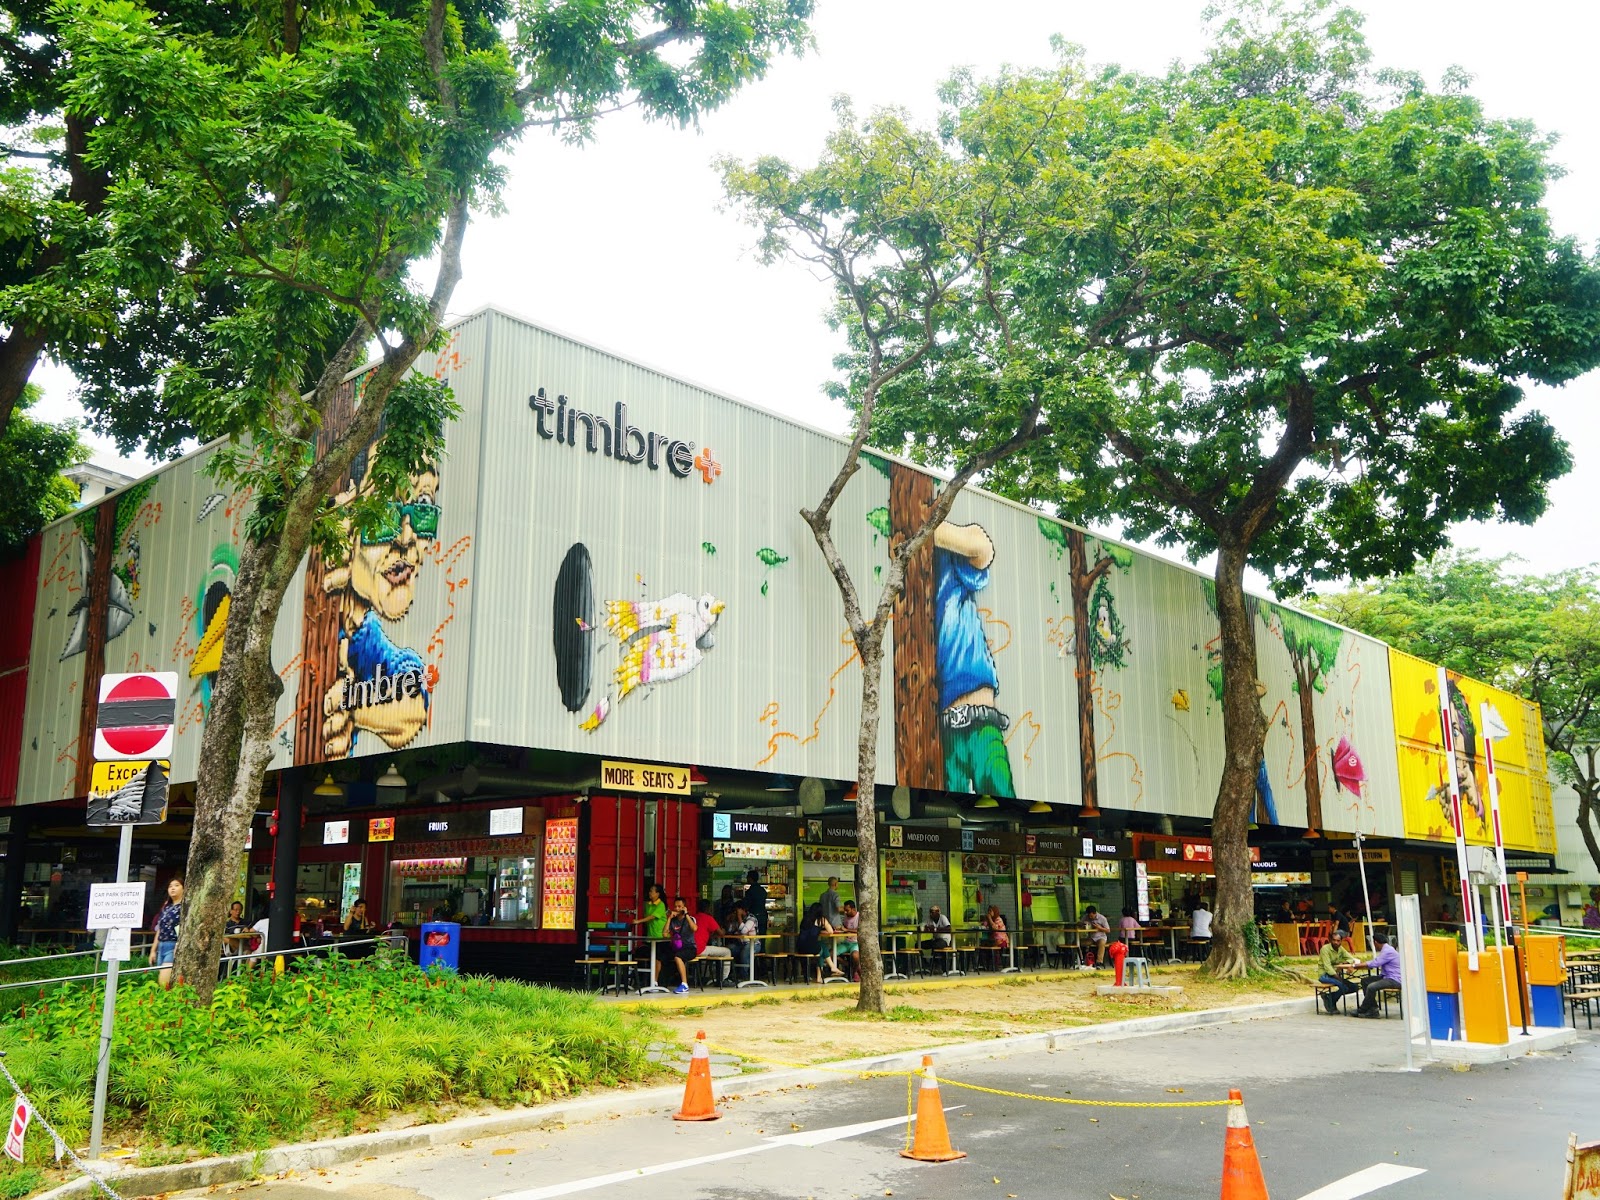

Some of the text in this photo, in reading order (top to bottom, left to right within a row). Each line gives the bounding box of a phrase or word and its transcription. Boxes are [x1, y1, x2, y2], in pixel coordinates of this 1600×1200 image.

[604, 767, 674, 789] MORE SEATS
[428, 821, 449, 832] FRUITS
[734, 821, 769, 833] TEH TARIK
[827, 828, 841, 837] NASI
[907, 832, 940, 842] MIXED FOOD
[977, 837, 1000, 846] NOODLES
[1344, 852, 1358, 860] TRAY
